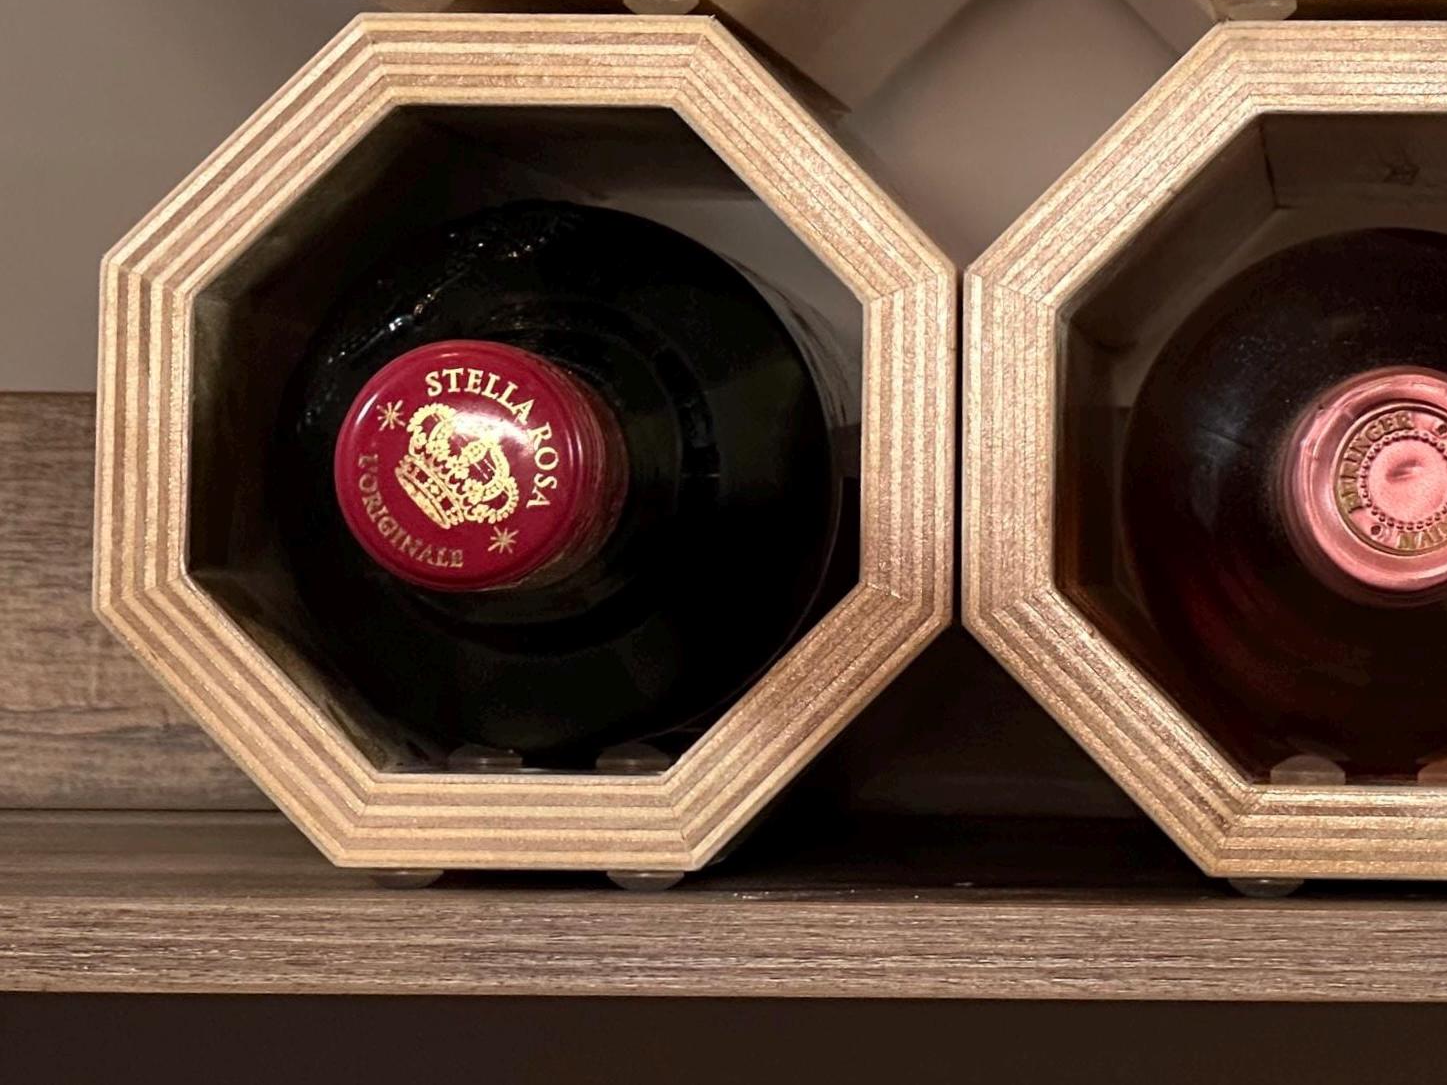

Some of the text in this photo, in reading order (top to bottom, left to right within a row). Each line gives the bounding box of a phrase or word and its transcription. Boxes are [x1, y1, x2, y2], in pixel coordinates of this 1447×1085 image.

[425, 367, 560, 509] STELLA ROSA
[358, 452, 464, 568] L'ORIGINALE
